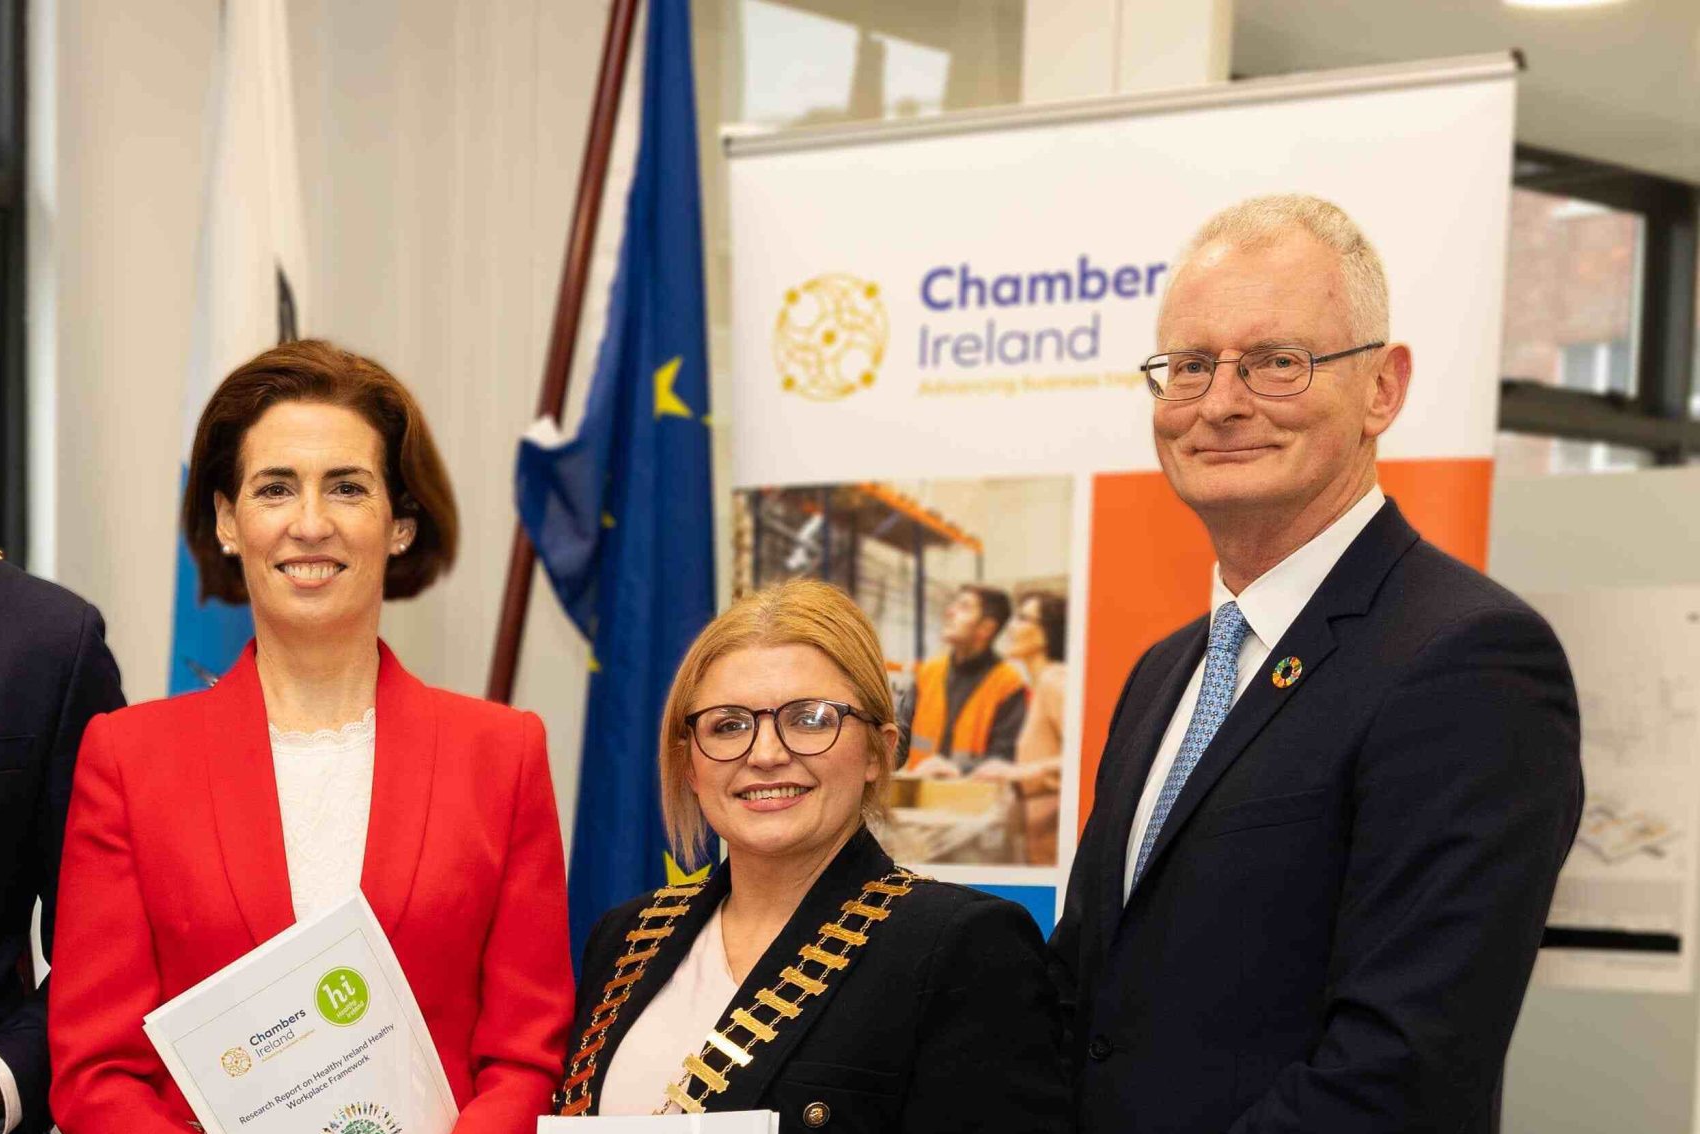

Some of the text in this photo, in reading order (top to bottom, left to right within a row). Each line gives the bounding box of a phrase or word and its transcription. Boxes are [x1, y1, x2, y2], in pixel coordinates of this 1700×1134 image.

[920, 253, 1167, 311] Chamber
[917, 312, 1101, 369] Ireland
[322, 974, 356, 1010] hi
[249, 1008, 306, 1046] Chambers
[255, 1028, 295, 1058] Ireland
[239, 1023, 395, 1124] Research Report on Healthy Ireland Healthy
[286, 1056, 370, 1110] Workplace Framework
